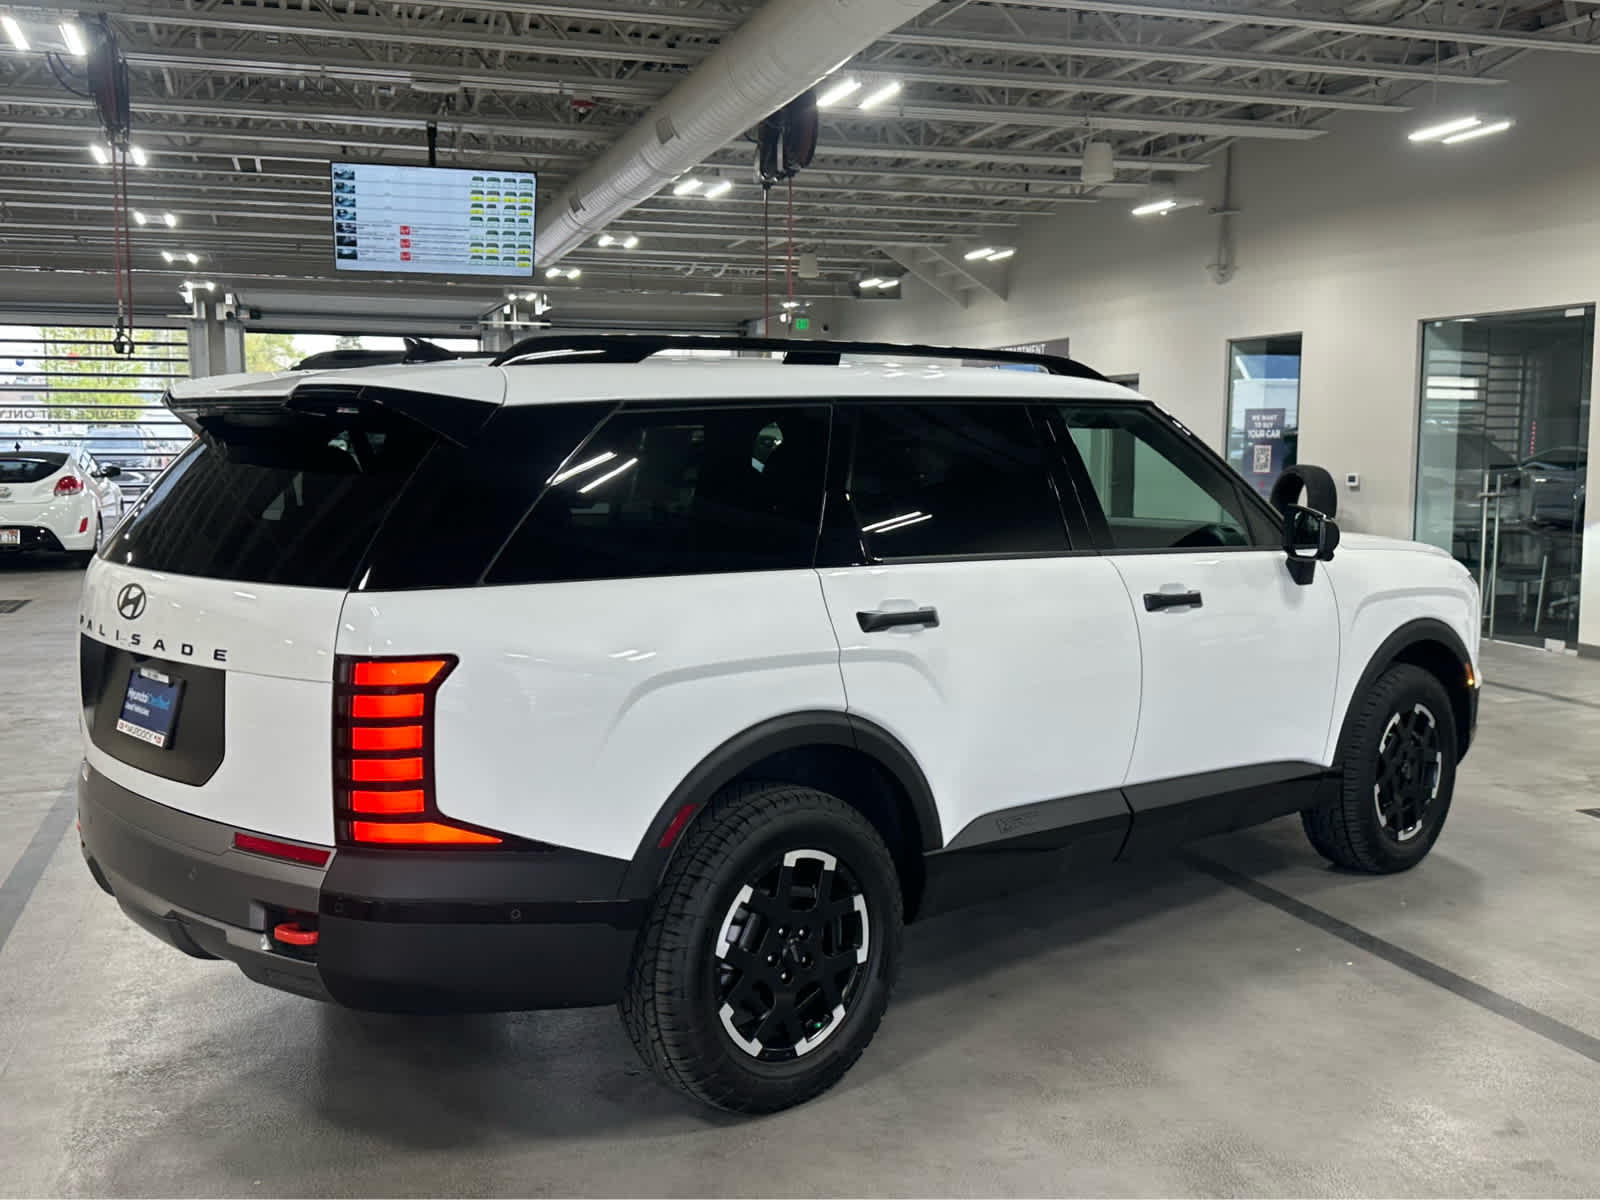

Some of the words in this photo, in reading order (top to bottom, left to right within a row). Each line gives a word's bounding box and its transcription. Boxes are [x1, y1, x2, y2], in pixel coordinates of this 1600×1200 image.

[1248, 429, 1264, 438] YOUR
[1265, 429, 1280, 438] CAR
[80, 615, 228, 662] PALISADE
